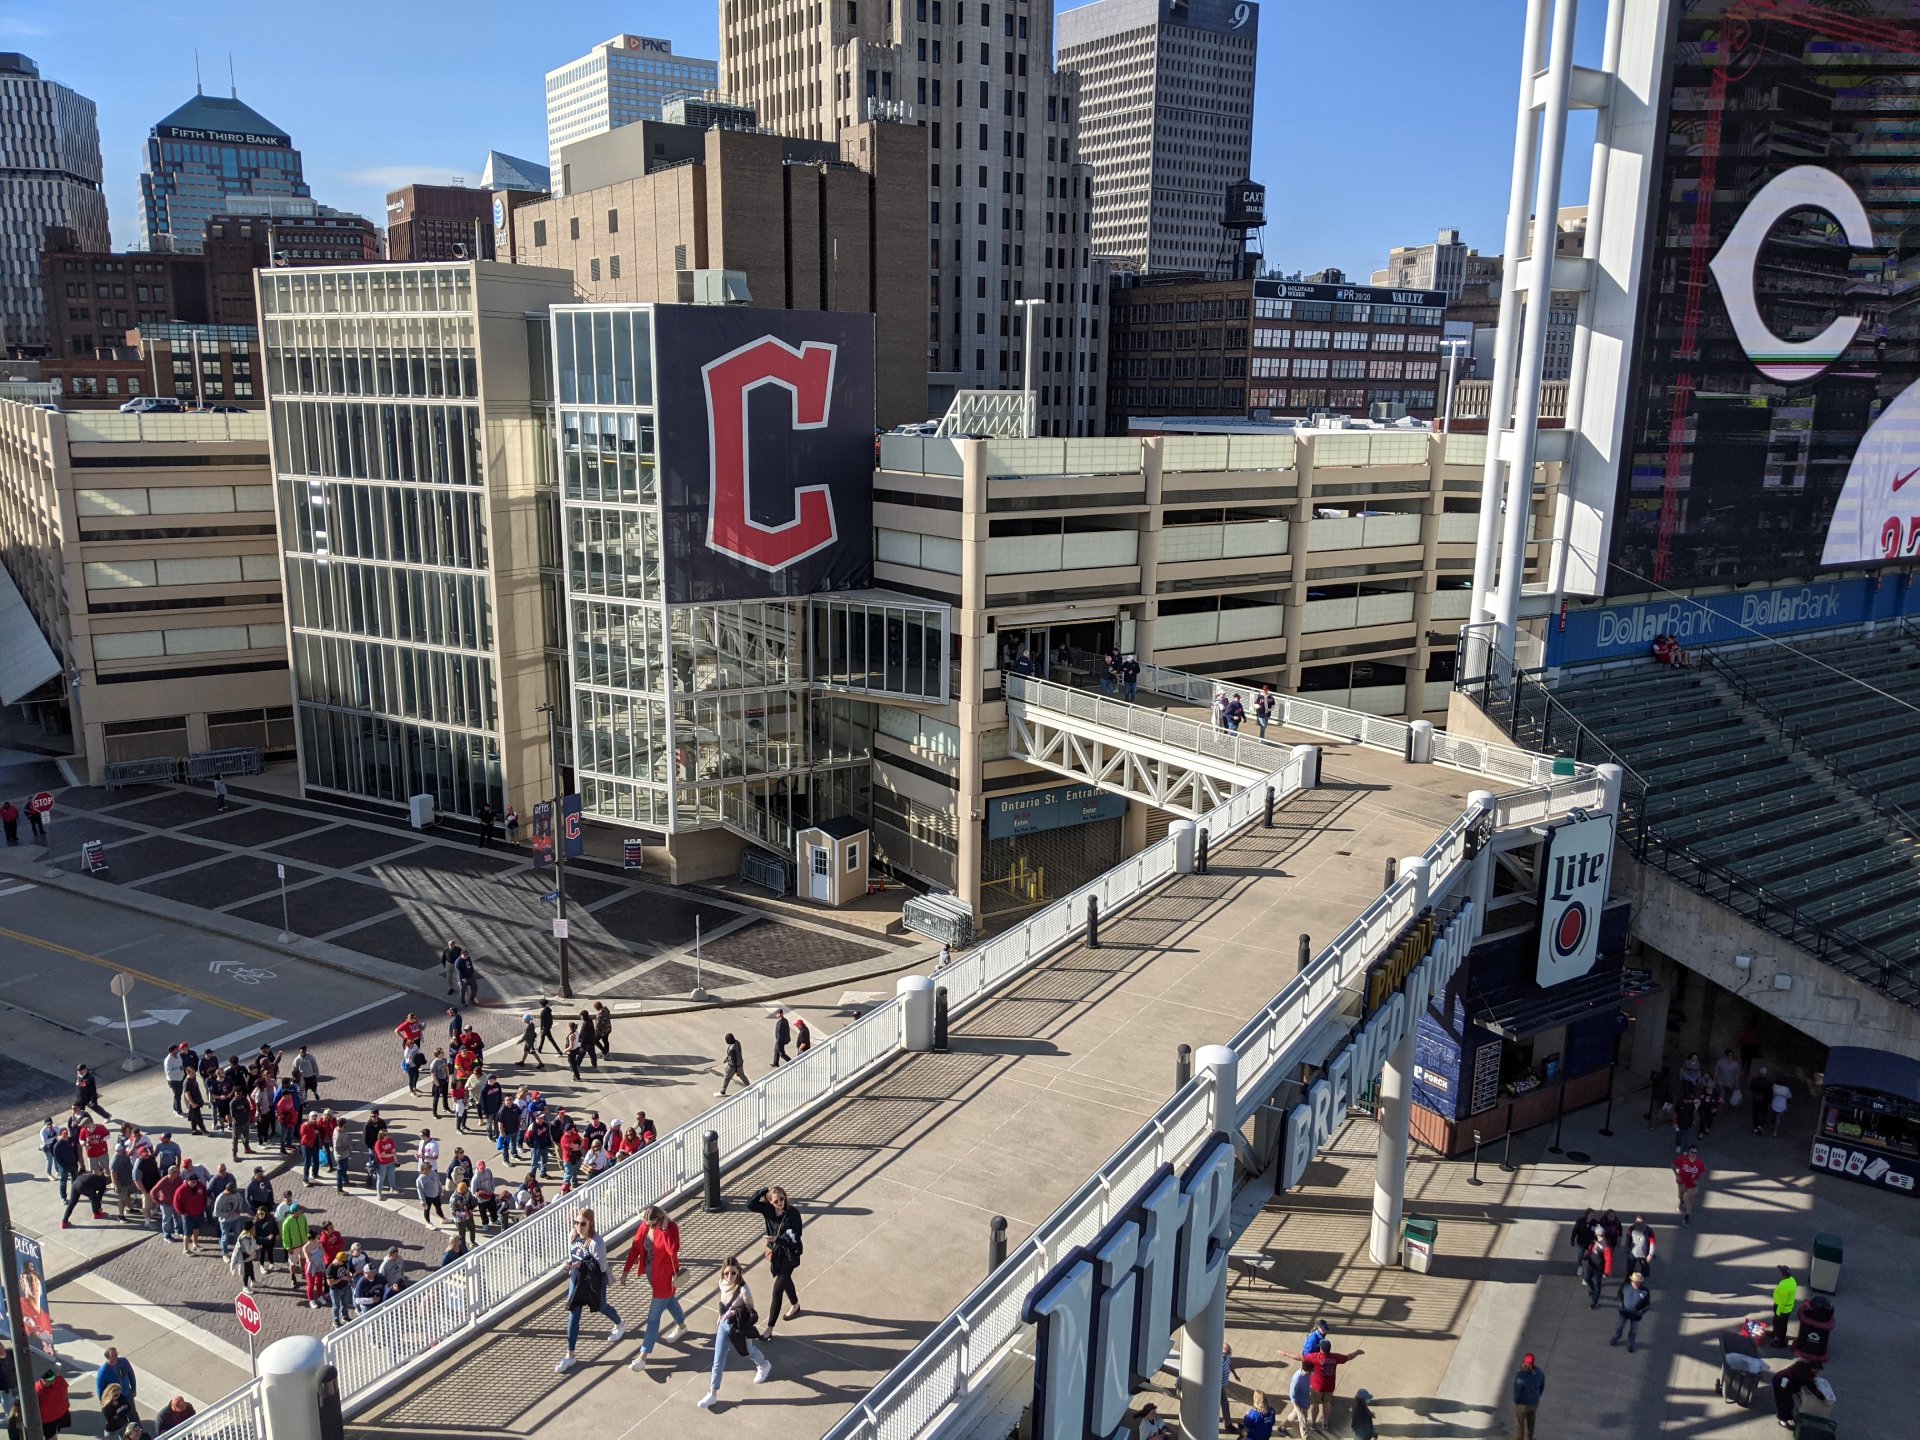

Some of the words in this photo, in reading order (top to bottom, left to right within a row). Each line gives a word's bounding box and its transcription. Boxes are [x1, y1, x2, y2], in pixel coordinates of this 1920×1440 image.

[1232, 3, 1250, 30] 9
[641, 38, 669, 53] PNC
[171, 127, 205, 139] FIFTH
[207, 130, 244, 143] THIRD
[246, 134, 278, 146] BANK
[1709, 165, 1873, 381] C
[1343, 289, 1355, 300] PR
[1355, 293, 1371, 301] 20/20
[1391, 291, 1425, 304] VAULTZ
[701, 334, 838, 573] C
[1741, 584, 1841, 628] DollarBank
[1597, 599, 1714, 648] DollarBank
[34, 796, 53, 809] STOP
[1001, 797, 1040, 812] Ontario
[1045, 794, 1058, 805] St.
[1083, 807, 1097, 815] Enter
[566, 812, 580, 840] C
[1014, 819, 1029, 827] Enter
[1551, 851, 1604, 902] Lite
[1369, 912, 1436, 1012] PROUDLY
[1283, 991, 1405, 1190] BREWED
[1428, 902, 1476, 997] OHIO
[1423, 1071, 1448, 1090] PORCH
[237, 1301, 259, 1326] STOP
